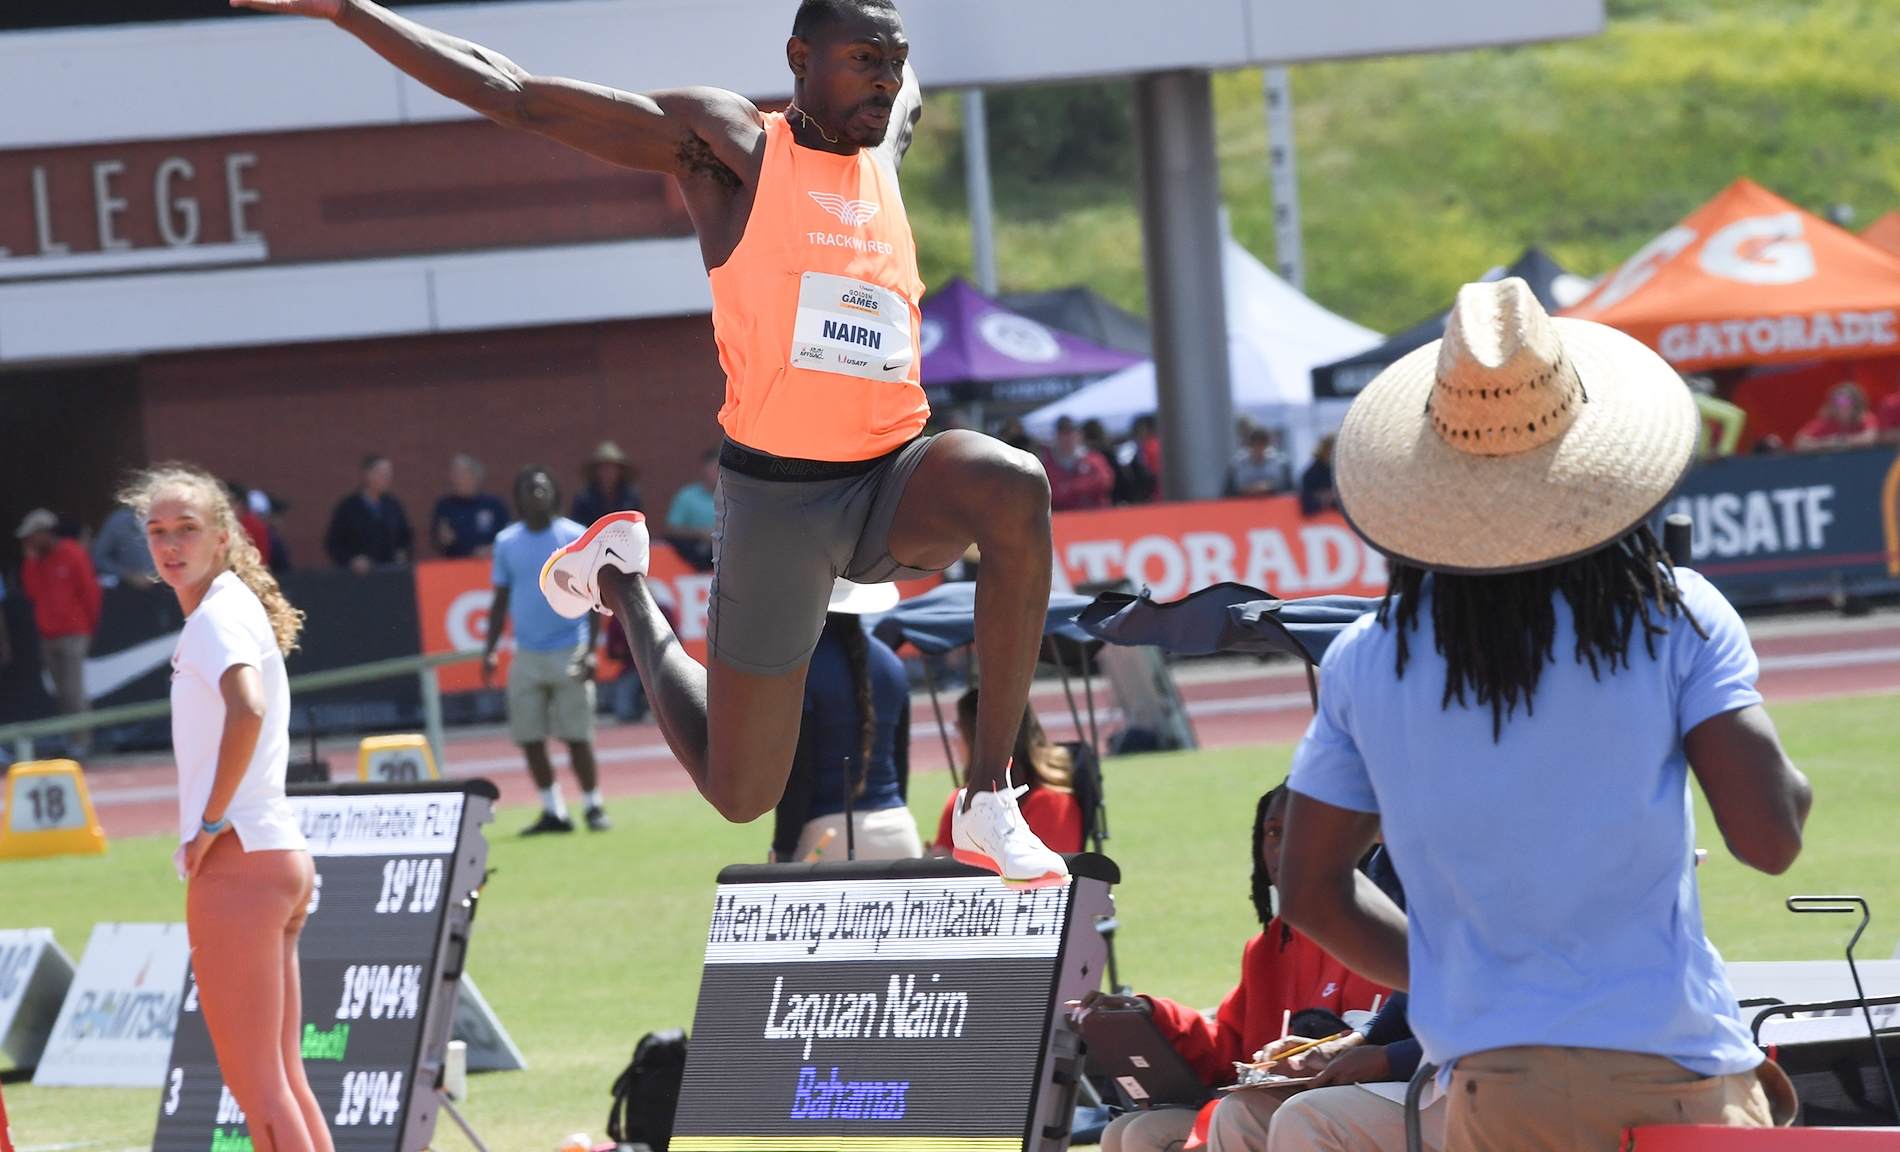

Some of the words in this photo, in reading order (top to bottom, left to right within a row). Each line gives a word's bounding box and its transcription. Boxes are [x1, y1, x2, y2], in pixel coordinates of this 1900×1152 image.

[0, 153, 264, 255] LEGE
[806, 232, 893, 255] TRACKWIRED
[841, 294, 879, 310] GAMES
[822, 319, 882, 350] NAIRN
[1658, 309, 1897, 361] GATORADE
[846, 358, 868, 367] USATF
[1678, 484, 1835, 560] USATF
[1050, 524, 1389, 604] TORAD
[27, 786, 66, 824] 18
[374, 858, 444, 914] 19'10
[710, 894, 763, 943] Men
[764, 893, 826, 955] Long
[828, 891, 895, 954] Jump
[764, 972, 878, 1061] Laquan
[878, 973, 969, 1038] Nairn
[164, 1067, 184, 1116] 3
[334, 1070, 403, 1126] 19'04
[789, 1066, 910, 1120] Bahamas
